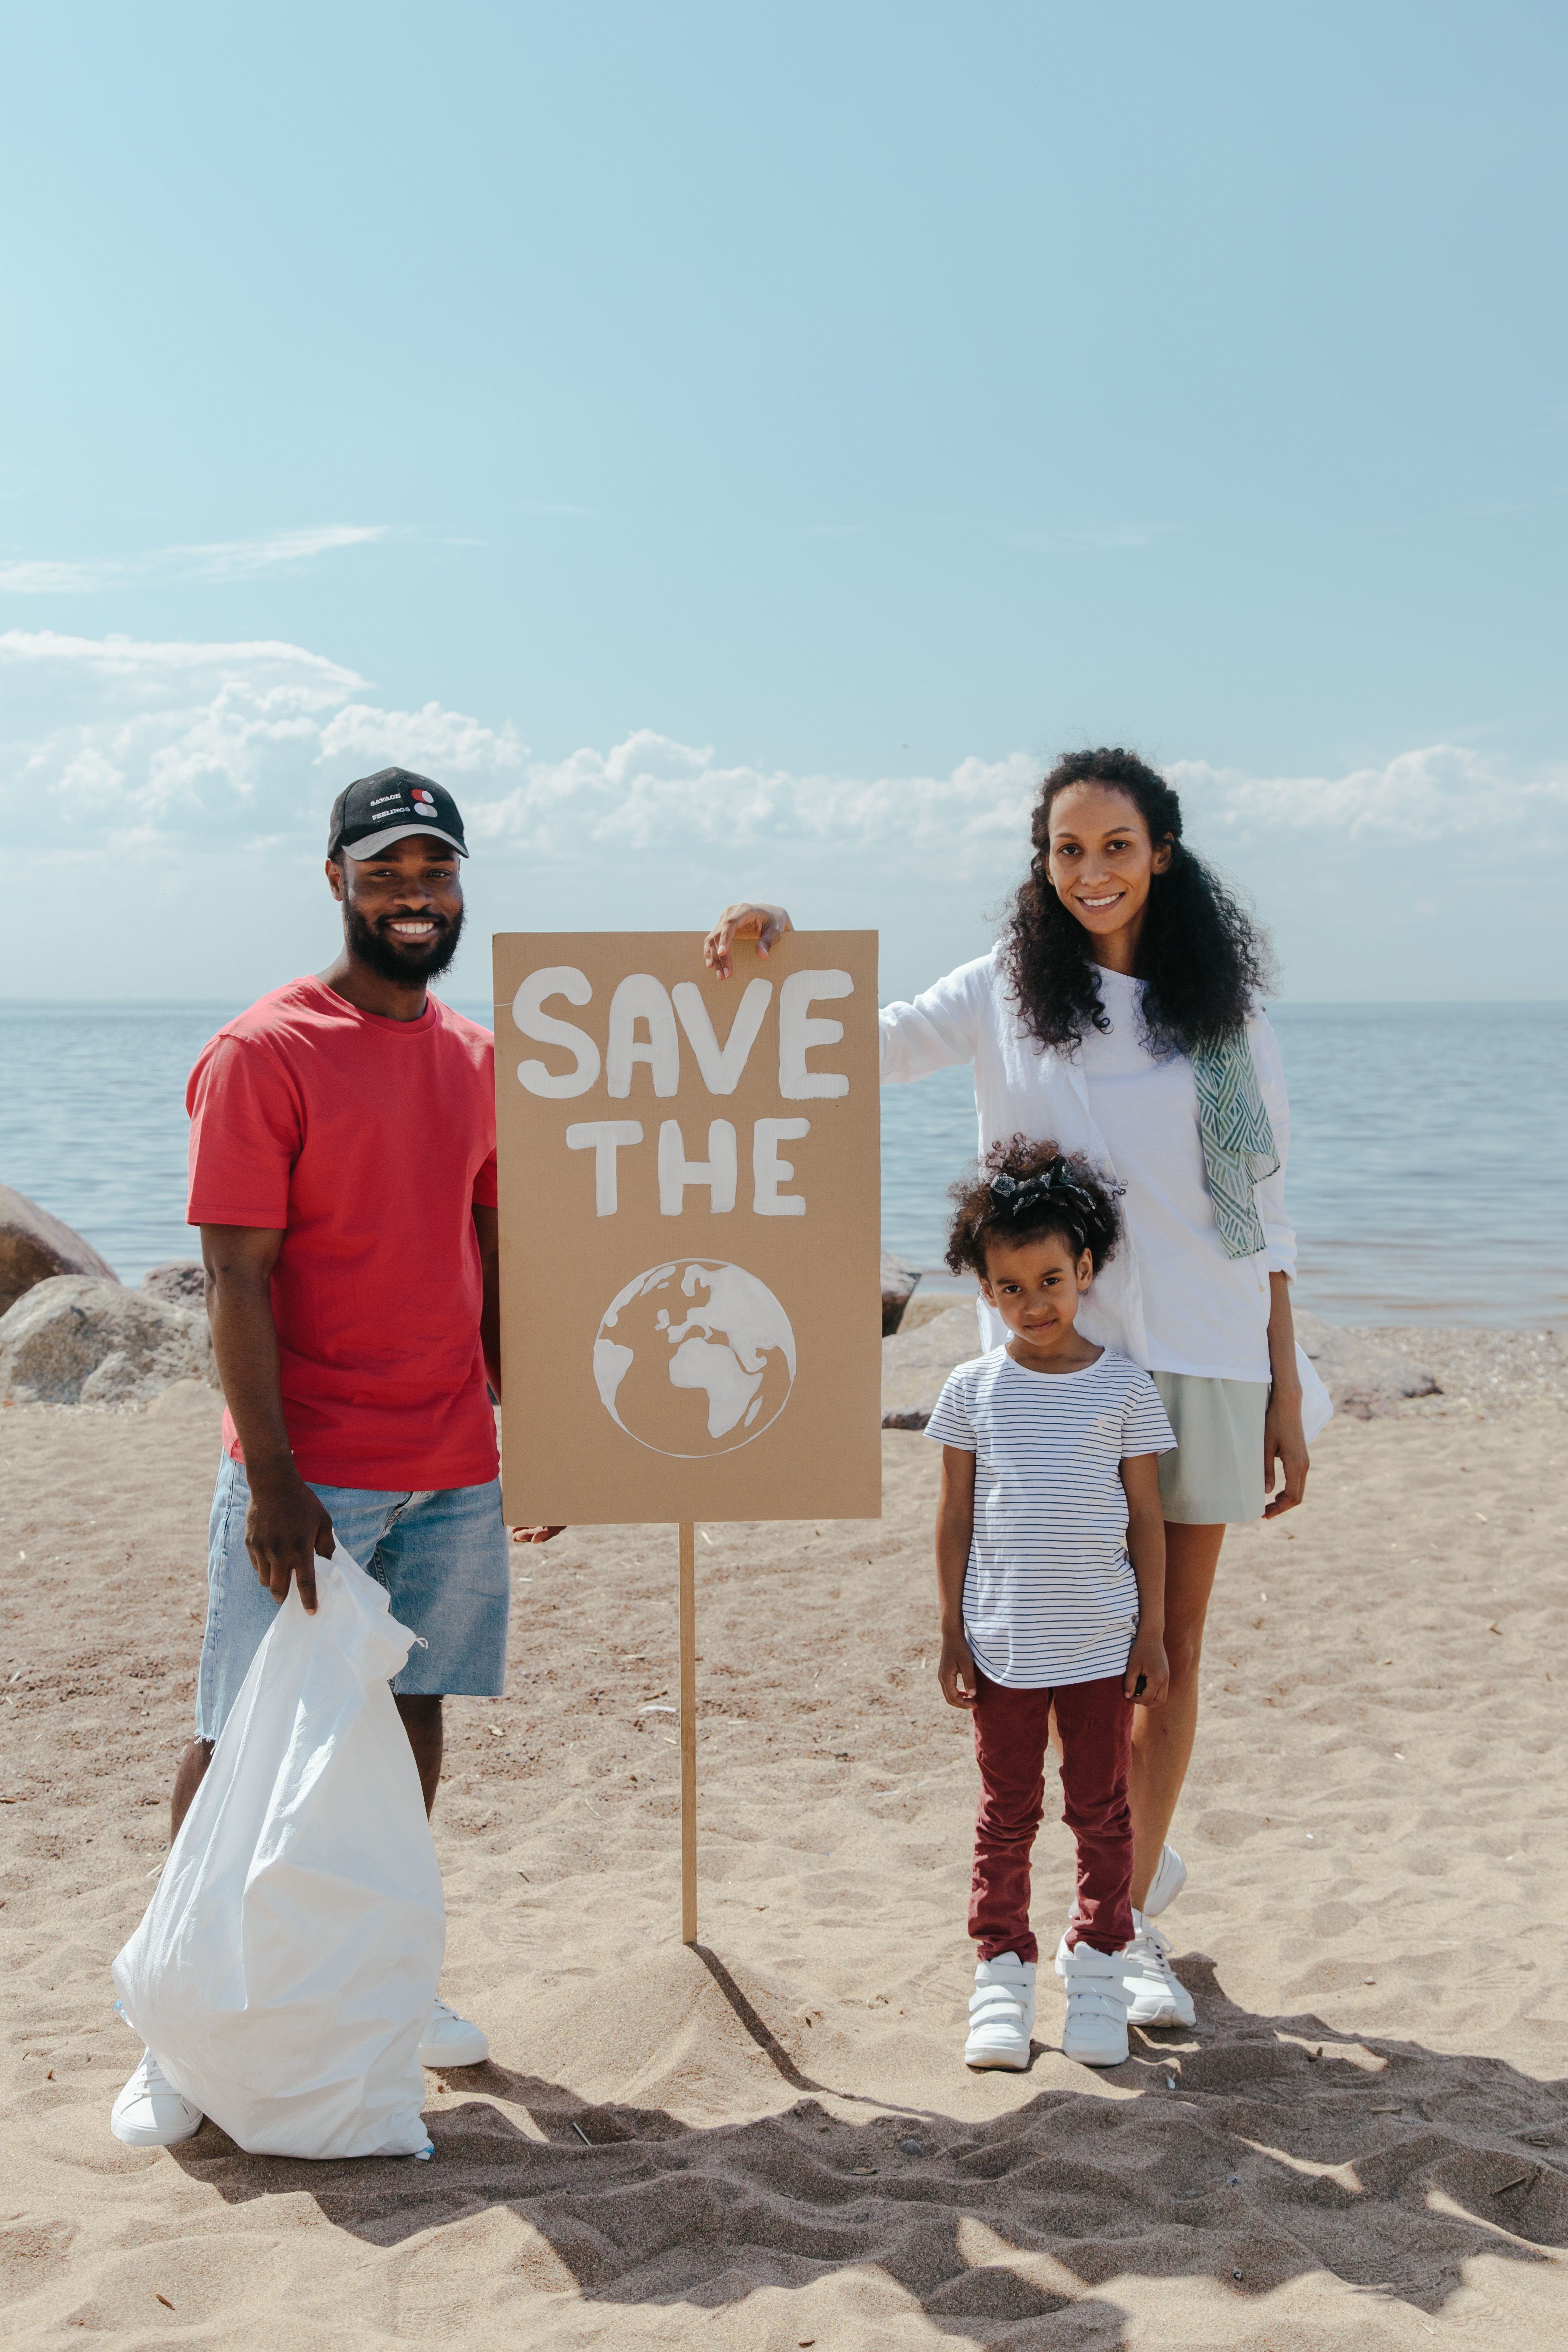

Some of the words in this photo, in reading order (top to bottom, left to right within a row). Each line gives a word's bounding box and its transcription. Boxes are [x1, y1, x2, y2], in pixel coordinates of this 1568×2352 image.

[370, 793, 401, 806] SAVAGE
[371, 807, 410, 821] FEELINGS
[512, 966, 854, 1100] SAVE
[566, 1118, 811, 1217] THE
